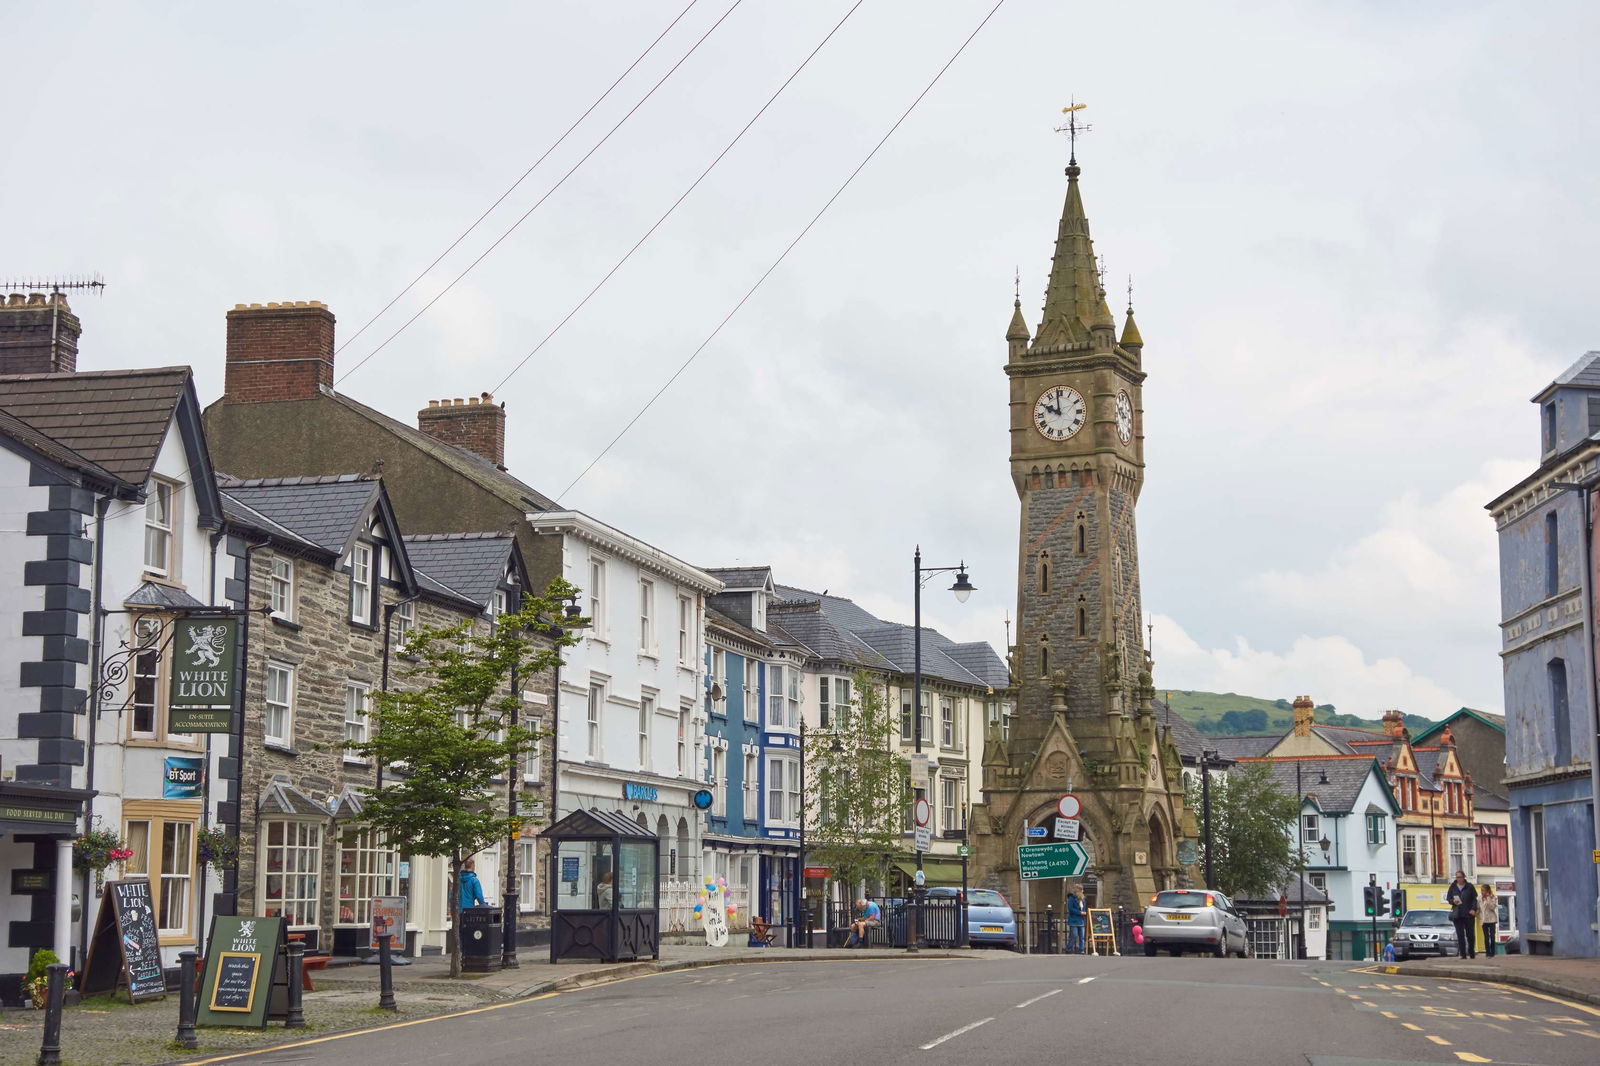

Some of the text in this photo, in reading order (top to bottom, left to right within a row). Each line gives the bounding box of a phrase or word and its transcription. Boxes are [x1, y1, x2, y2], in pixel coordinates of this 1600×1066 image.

[180, 670, 228, 682] WHITE
[178, 682, 228, 697] LION
[170, 770, 196, 782] BT Sport
[633, 784, 658, 801] BARCLAYS
[6, 808, 21, 817] FOOD
[24, 810, 42, 818] SERVED
[54, 812, 64, 820] DAY
[117, 884, 148, 897] WHITE
[124, 898, 144, 908] LION
